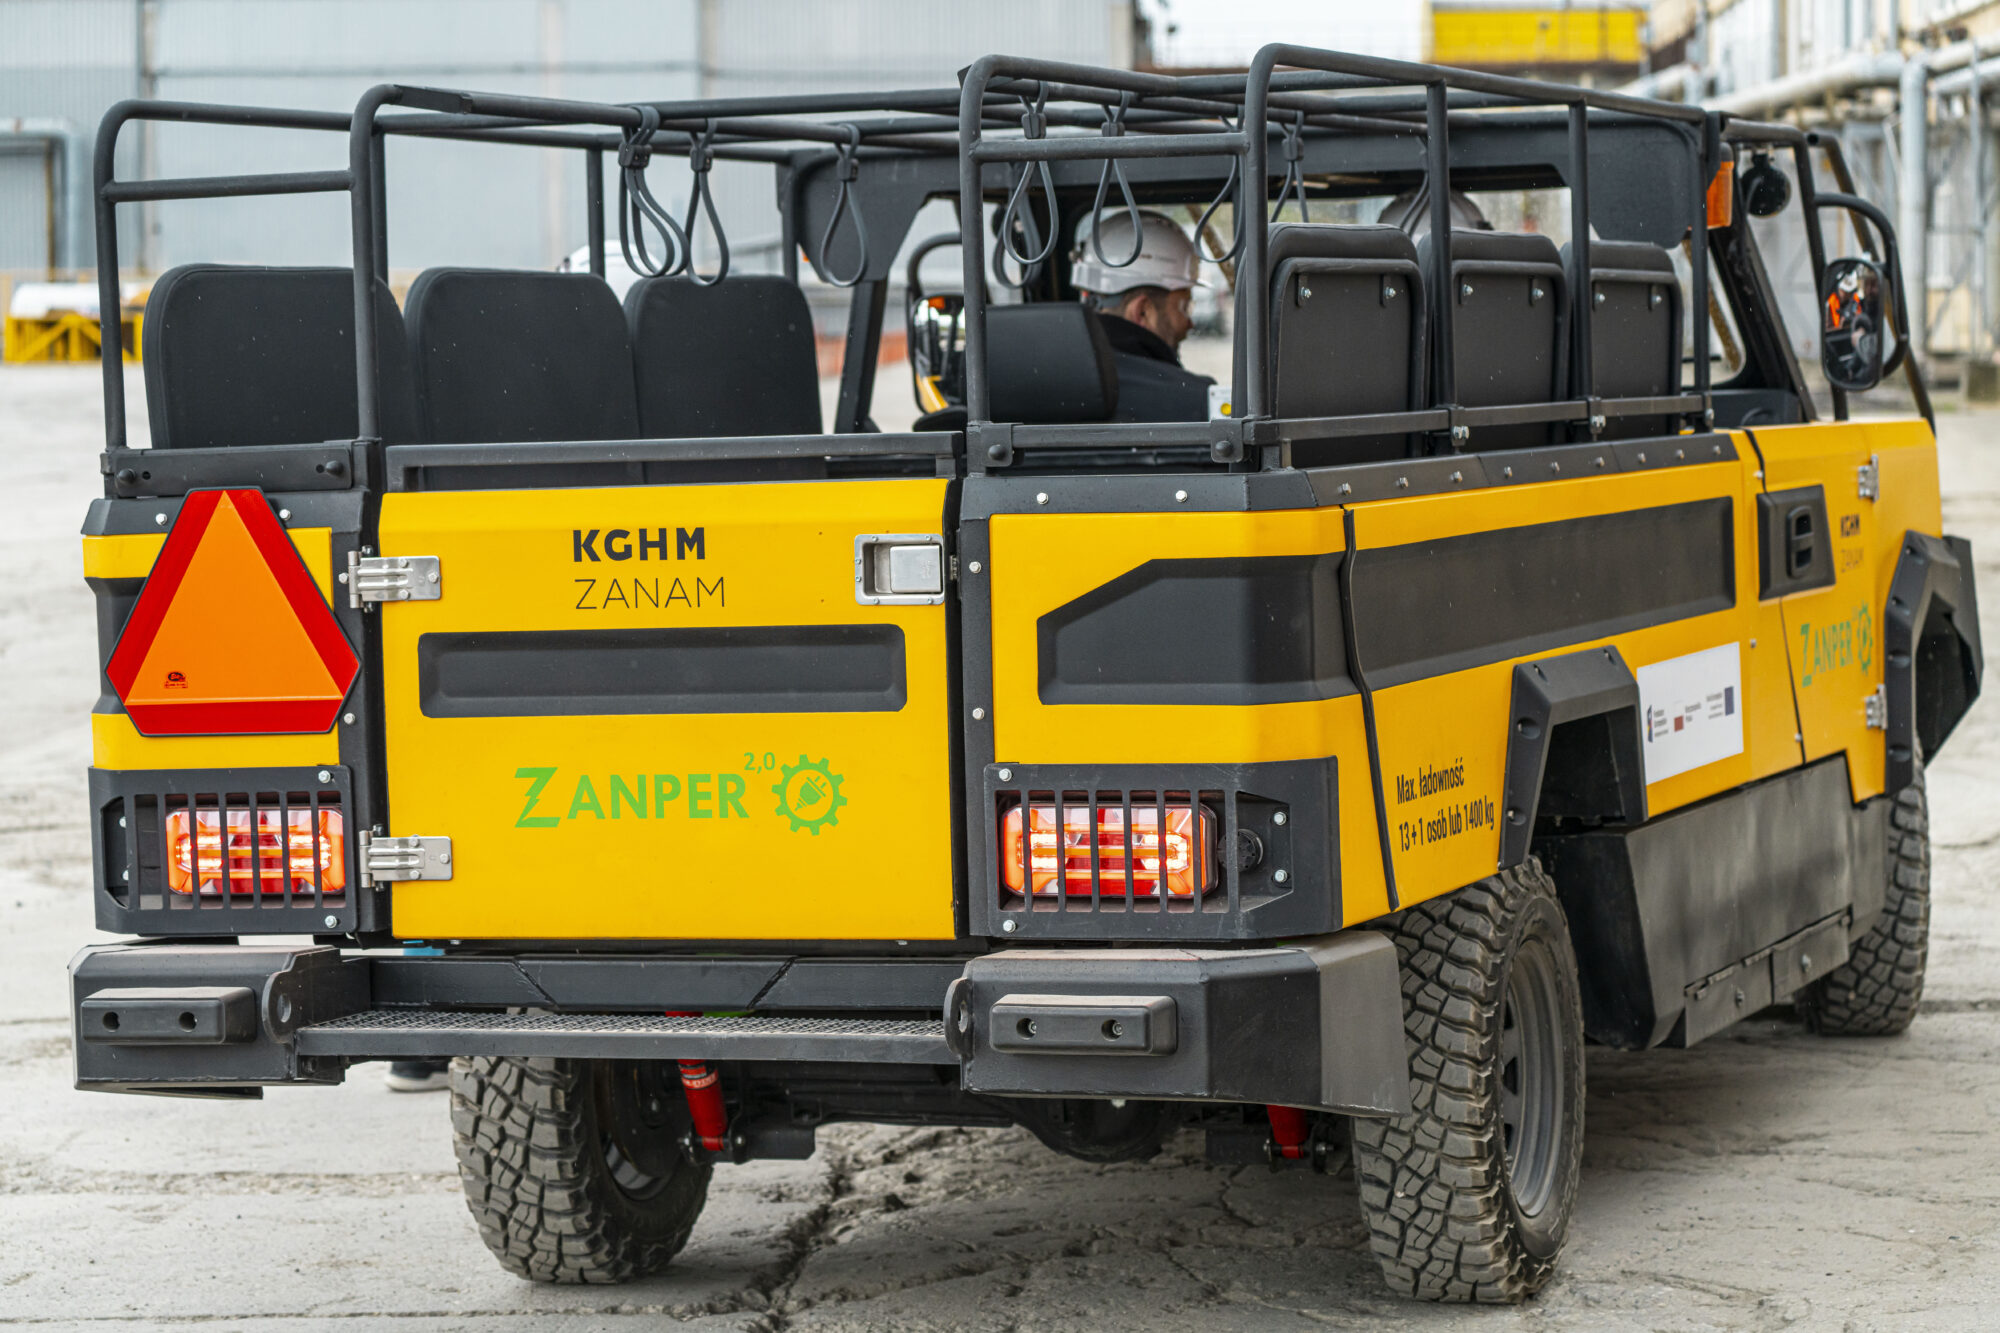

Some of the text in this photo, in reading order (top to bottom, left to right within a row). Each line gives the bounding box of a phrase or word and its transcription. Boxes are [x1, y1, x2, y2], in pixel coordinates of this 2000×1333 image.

[573, 527, 706, 562] KGHM
[574, 576, 725, 610] ZANAM
[1800, 621, 1854, 688] ZANPER
[514, 752, 776, 828] ZANPER 2,0
[1396, 756, 1465, 805] Max. ładowność
[1427, 808, 1448, 844] osób
[1448, 804, 1462, 837] lub
[1463, 798, 1484, 831] 1400
[1484, 795, 1495, 831] kg
